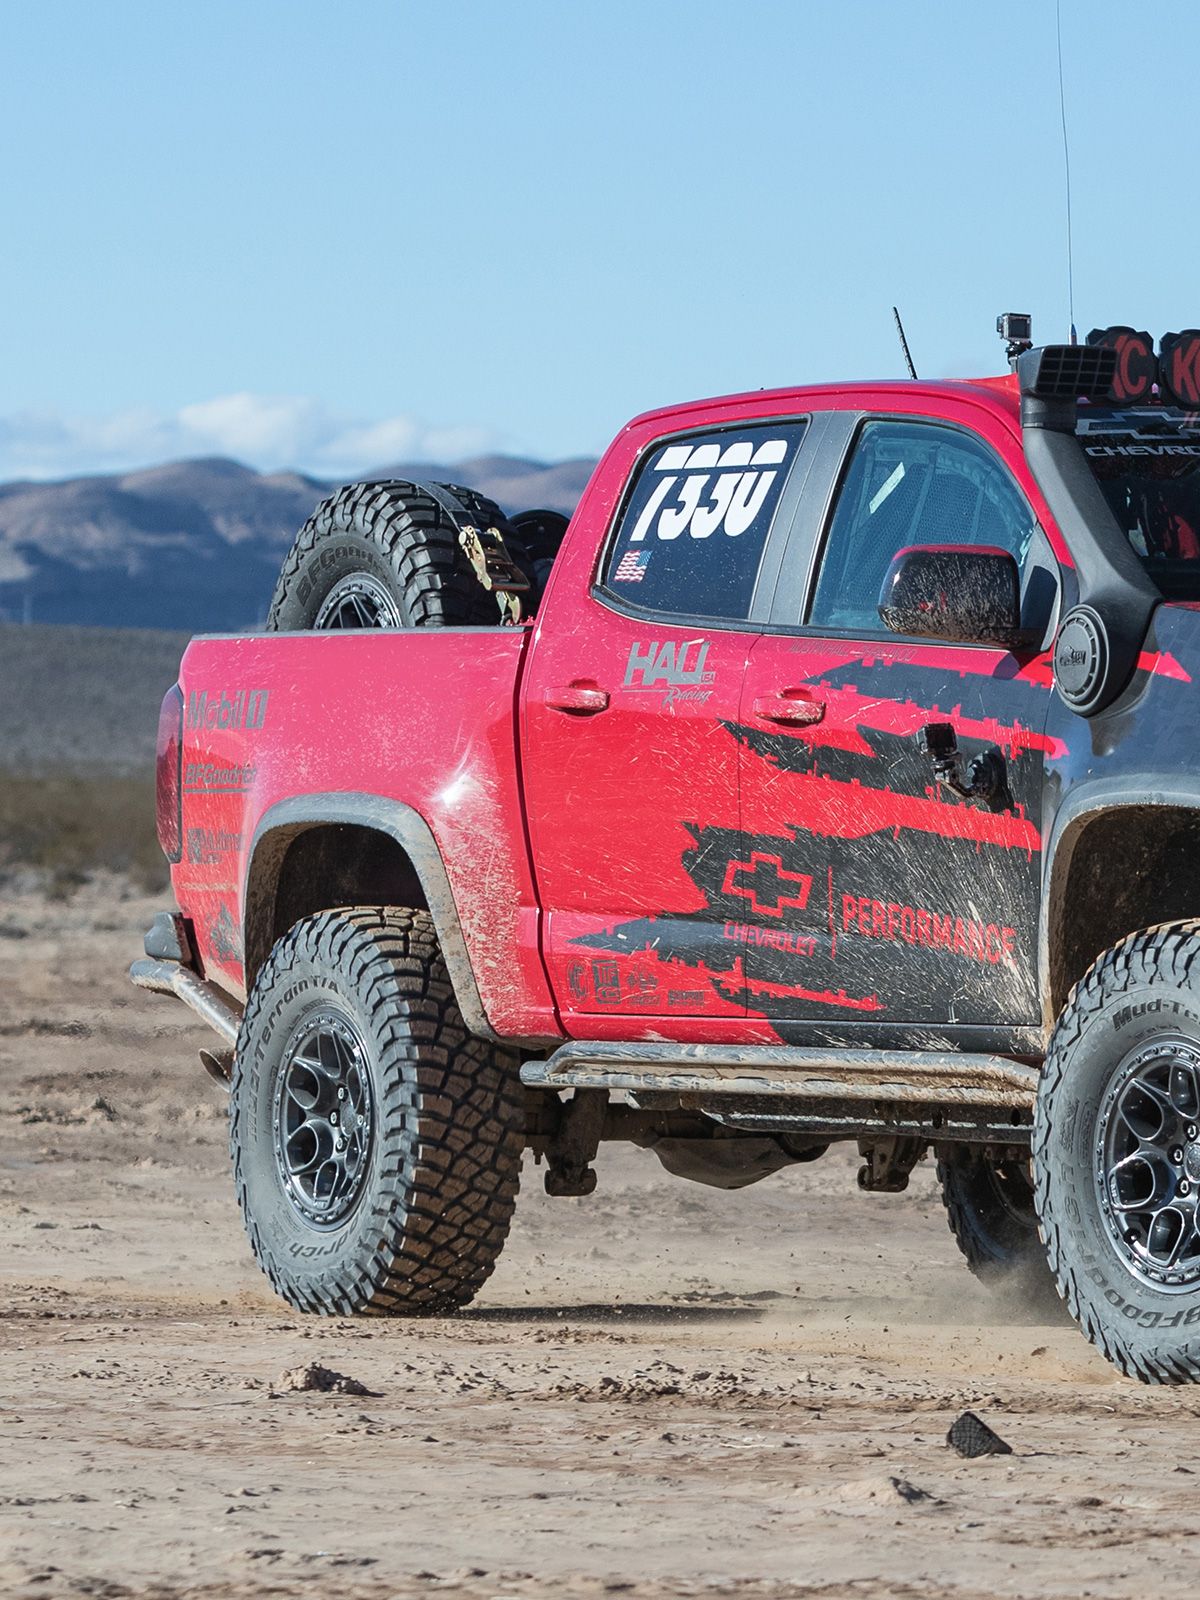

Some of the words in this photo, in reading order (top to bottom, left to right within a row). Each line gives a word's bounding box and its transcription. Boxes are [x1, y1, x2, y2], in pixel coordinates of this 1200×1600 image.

[623, 641, 710, 687] HALL
[186, 689, 246, 731] Mobil
[245, 689, 269, 729] 1
[723, 920, 817, 957] CHEVROLET
[841, 894, 1018, 965] PERFORMANCE
